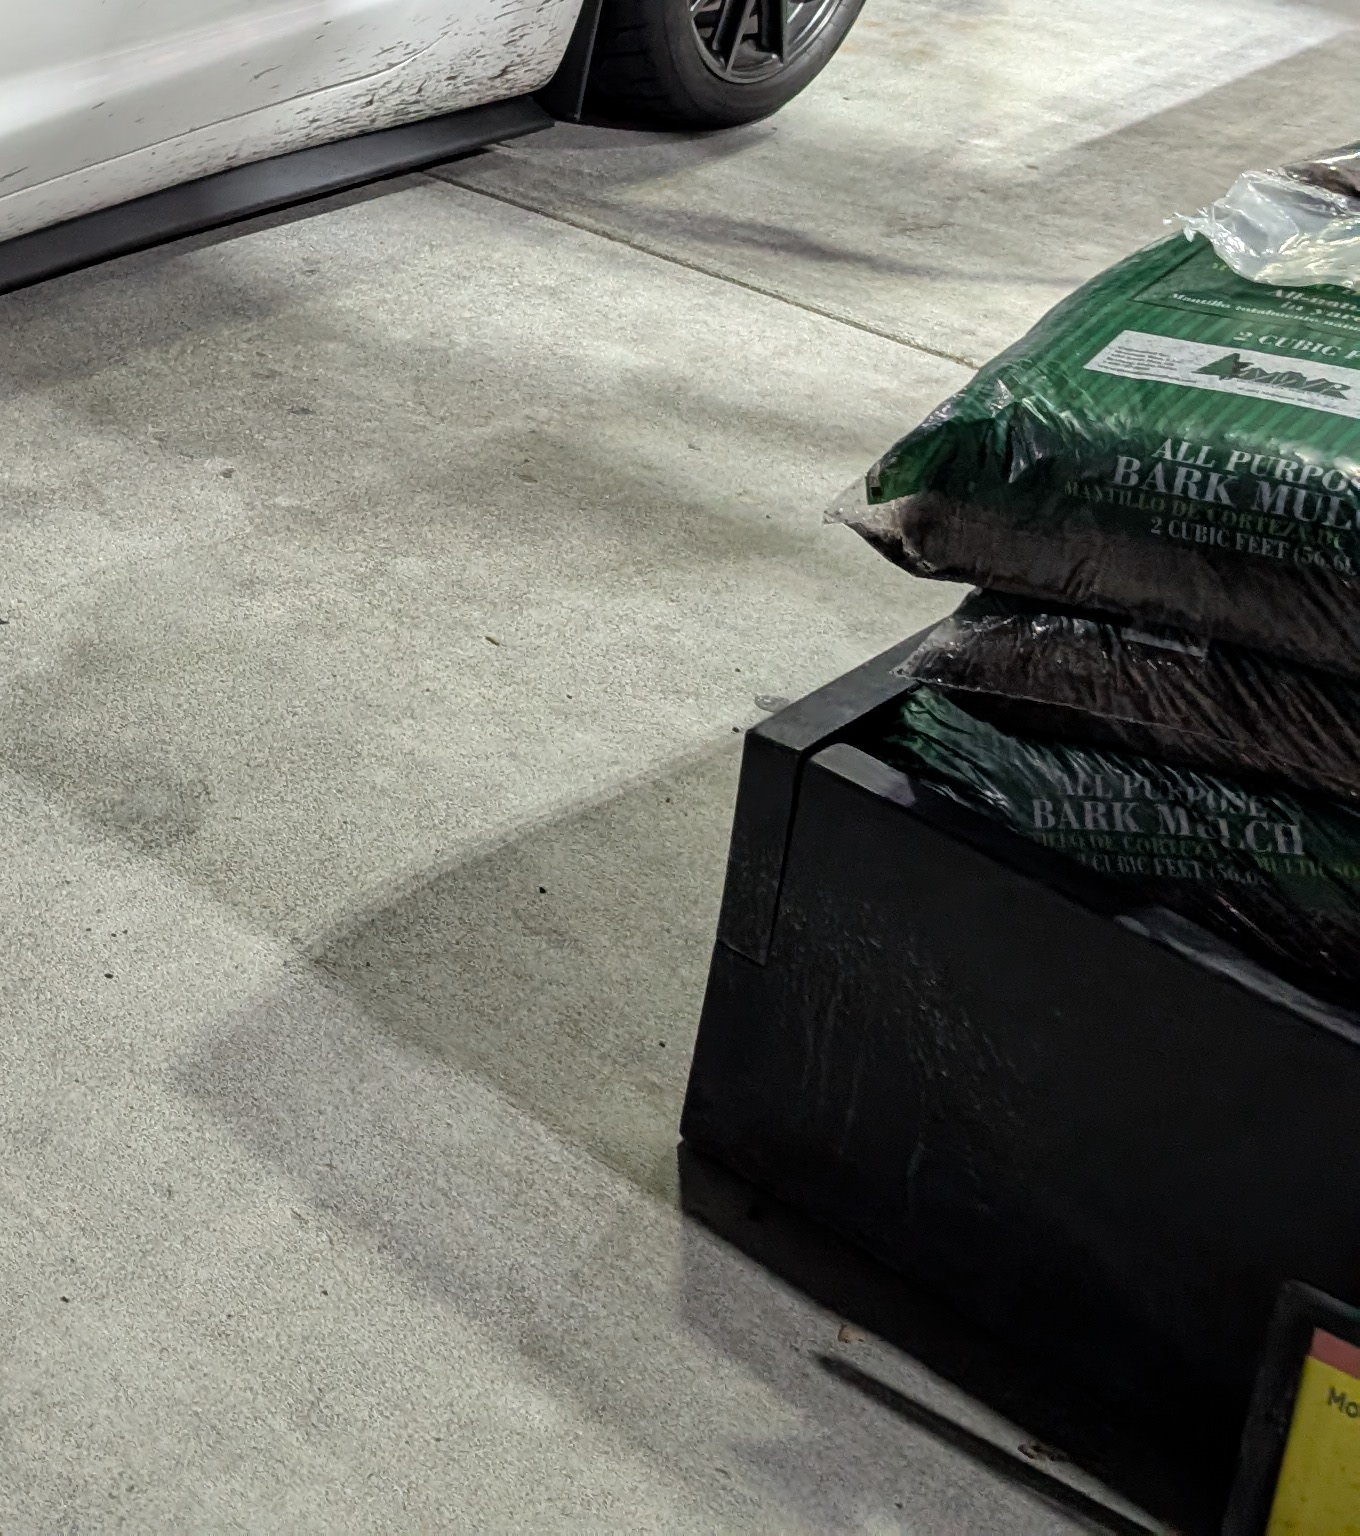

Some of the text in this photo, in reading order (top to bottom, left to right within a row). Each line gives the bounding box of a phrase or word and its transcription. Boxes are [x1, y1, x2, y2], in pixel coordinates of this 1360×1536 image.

[1258, 333, 1342, 357] CUBIC
[1151, 438, 1215, 468] ALL
[1112, 455, 1360, 531] BARK MUL
[1150, 516, 1163, 534] 2
[1168, 520, 1231, 548] CUBIC
[1234, 532, 1290, 559] FEET
[1032, 799, 1142, 834] BARK
